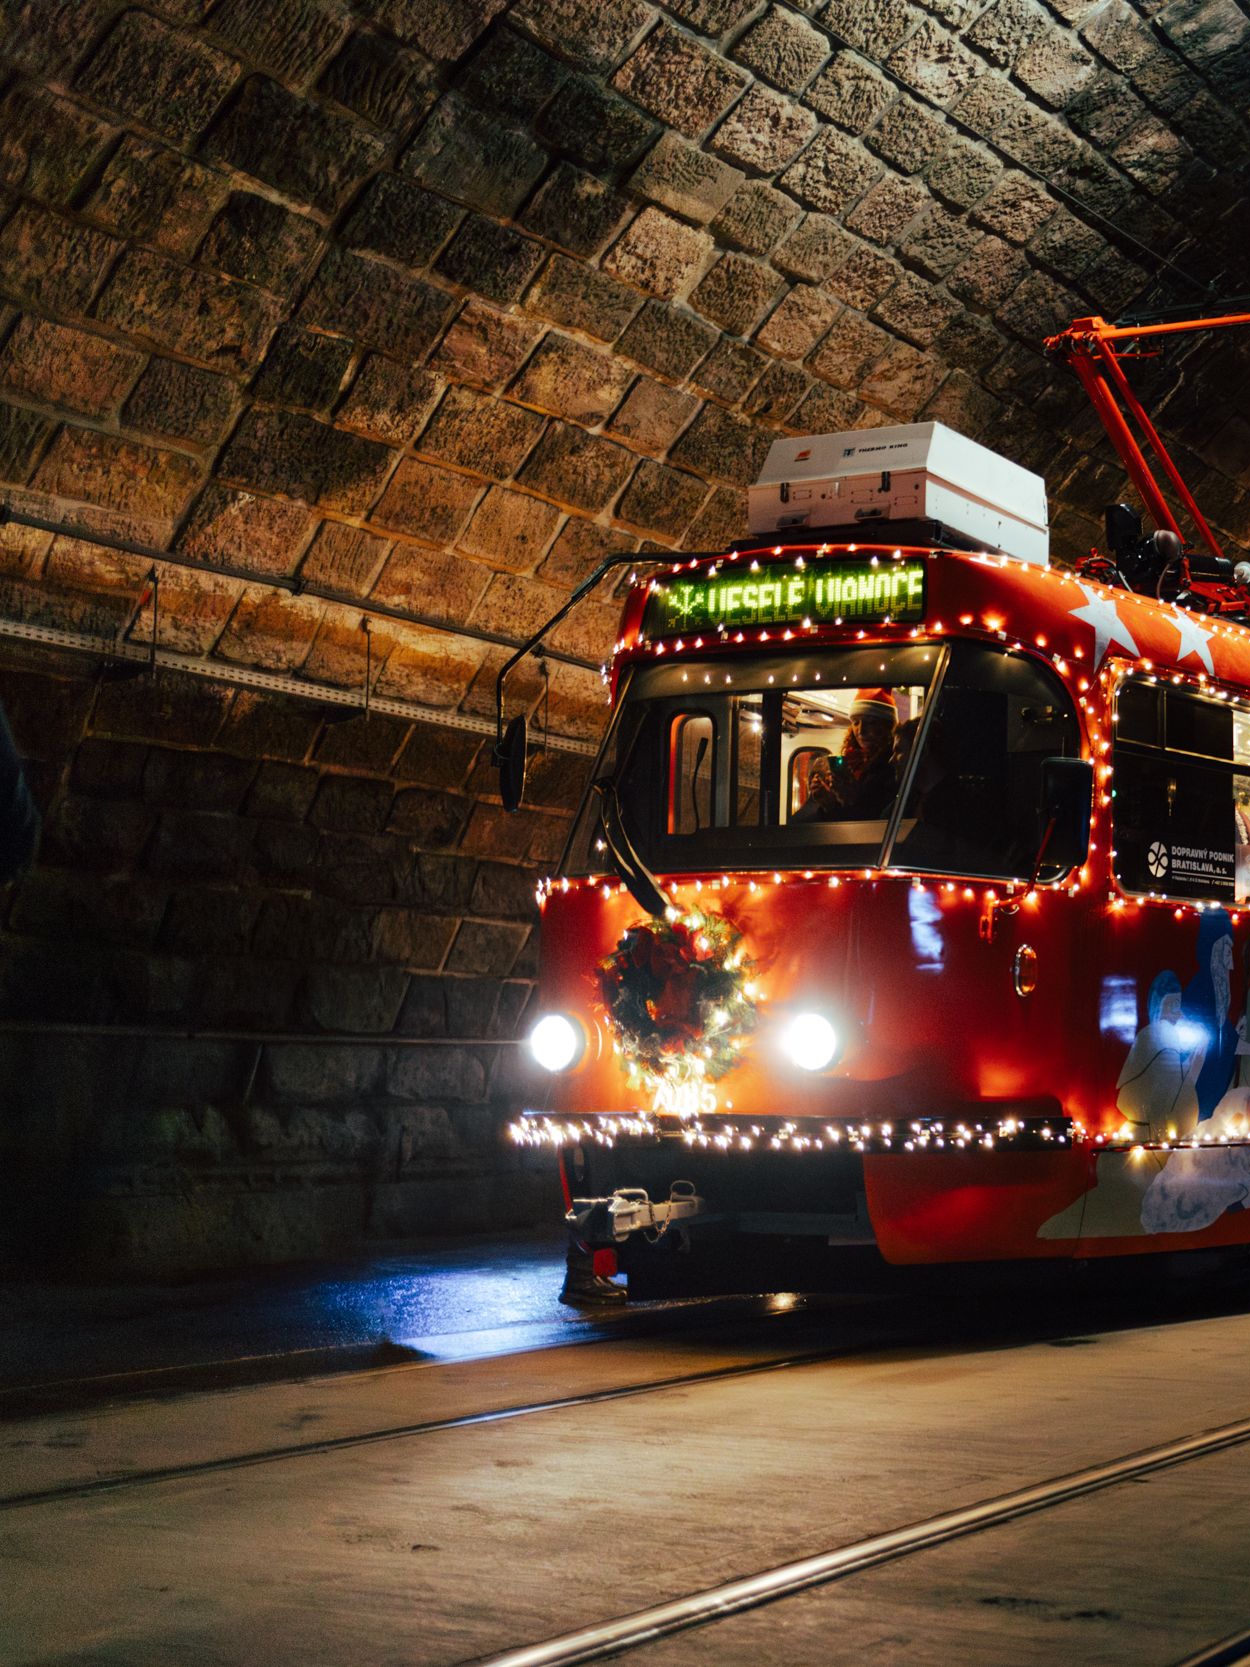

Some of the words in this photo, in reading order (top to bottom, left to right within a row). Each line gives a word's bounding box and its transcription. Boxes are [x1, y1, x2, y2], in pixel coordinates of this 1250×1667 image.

[1171, 846, 1208, 859] DOPRAVNÝ
[1209, 851, 1234, 863] PODNIK
[1171, 859, 1215, 874] BRATISLAVA,
